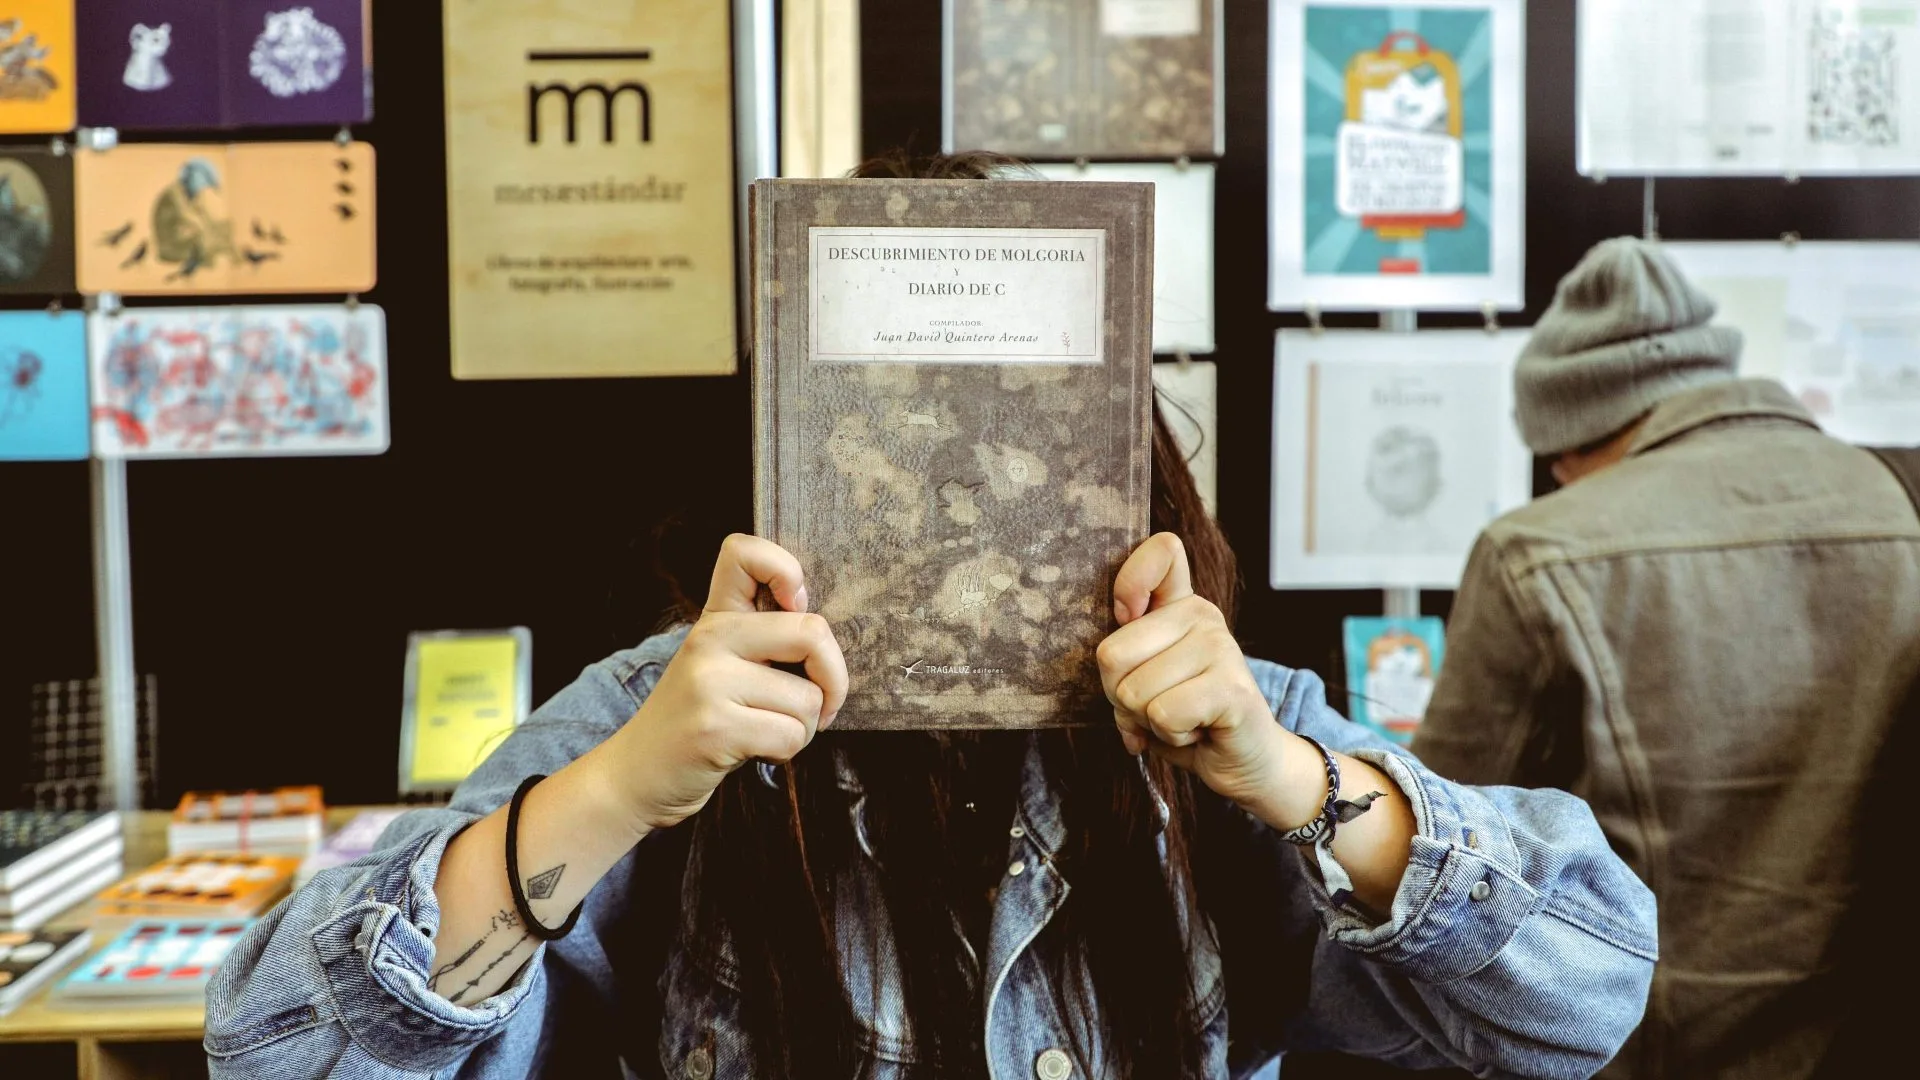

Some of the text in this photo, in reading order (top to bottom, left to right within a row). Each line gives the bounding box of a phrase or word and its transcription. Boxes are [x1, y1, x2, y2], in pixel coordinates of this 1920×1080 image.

[828, 247, 1085, 262] DESCUBRIMIENTO DE MOLGORIA
[954, 268, 960, 276] Y
[909, 283, 1006, 296] DIARIO DE C
[873, 331, 1039, 344] Juan David Quintero Arenas
[926, 665, 970, 674] TRAGALUZ
